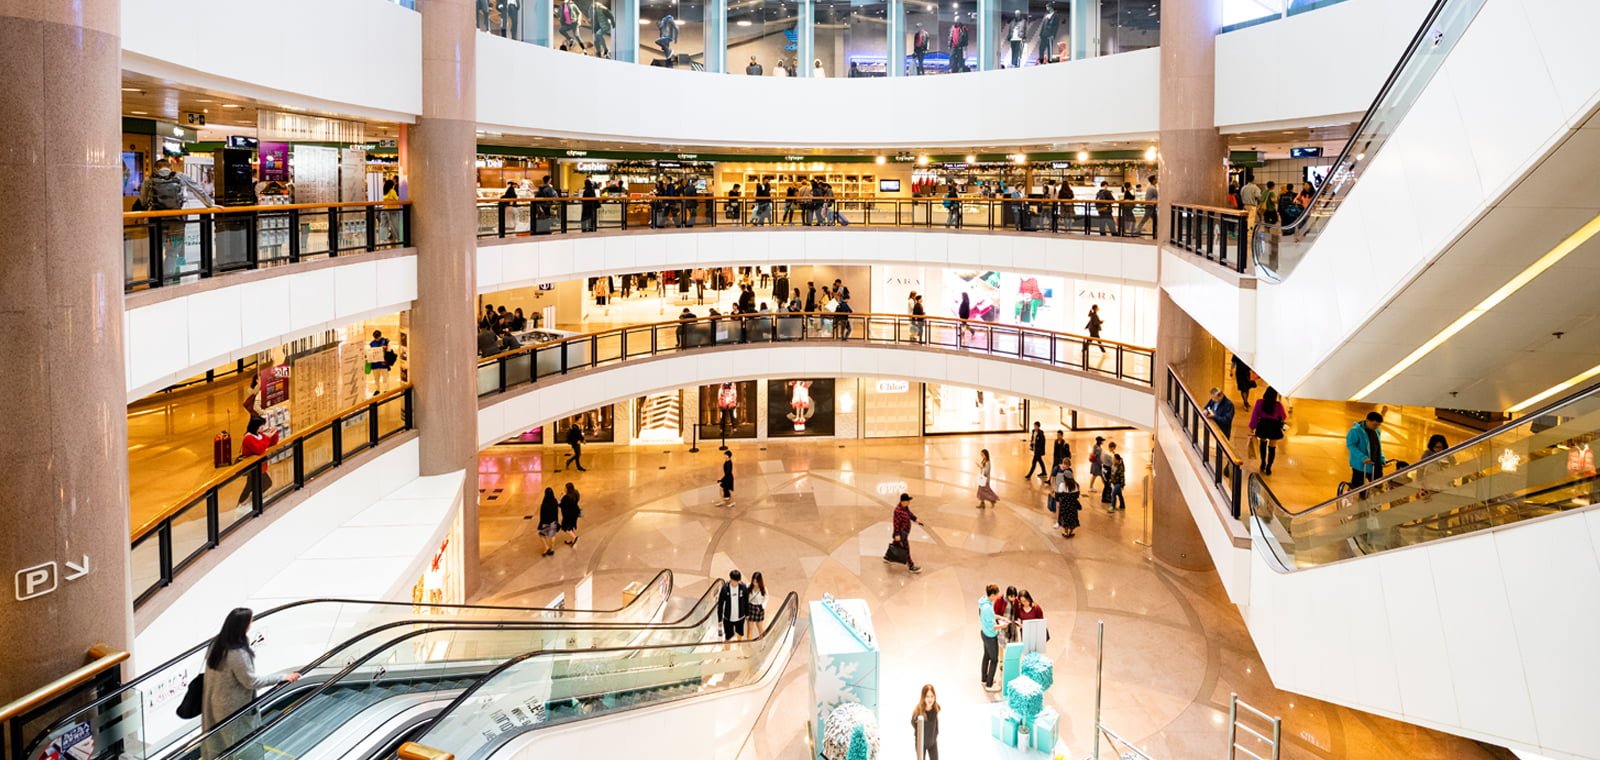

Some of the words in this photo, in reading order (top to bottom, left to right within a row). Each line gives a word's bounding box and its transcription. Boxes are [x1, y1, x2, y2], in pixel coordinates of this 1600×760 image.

[577, 161, 608, 171] Cashier
[1078, 290, 1116, 300] ZARA
[27, 570, 48, 594] P
